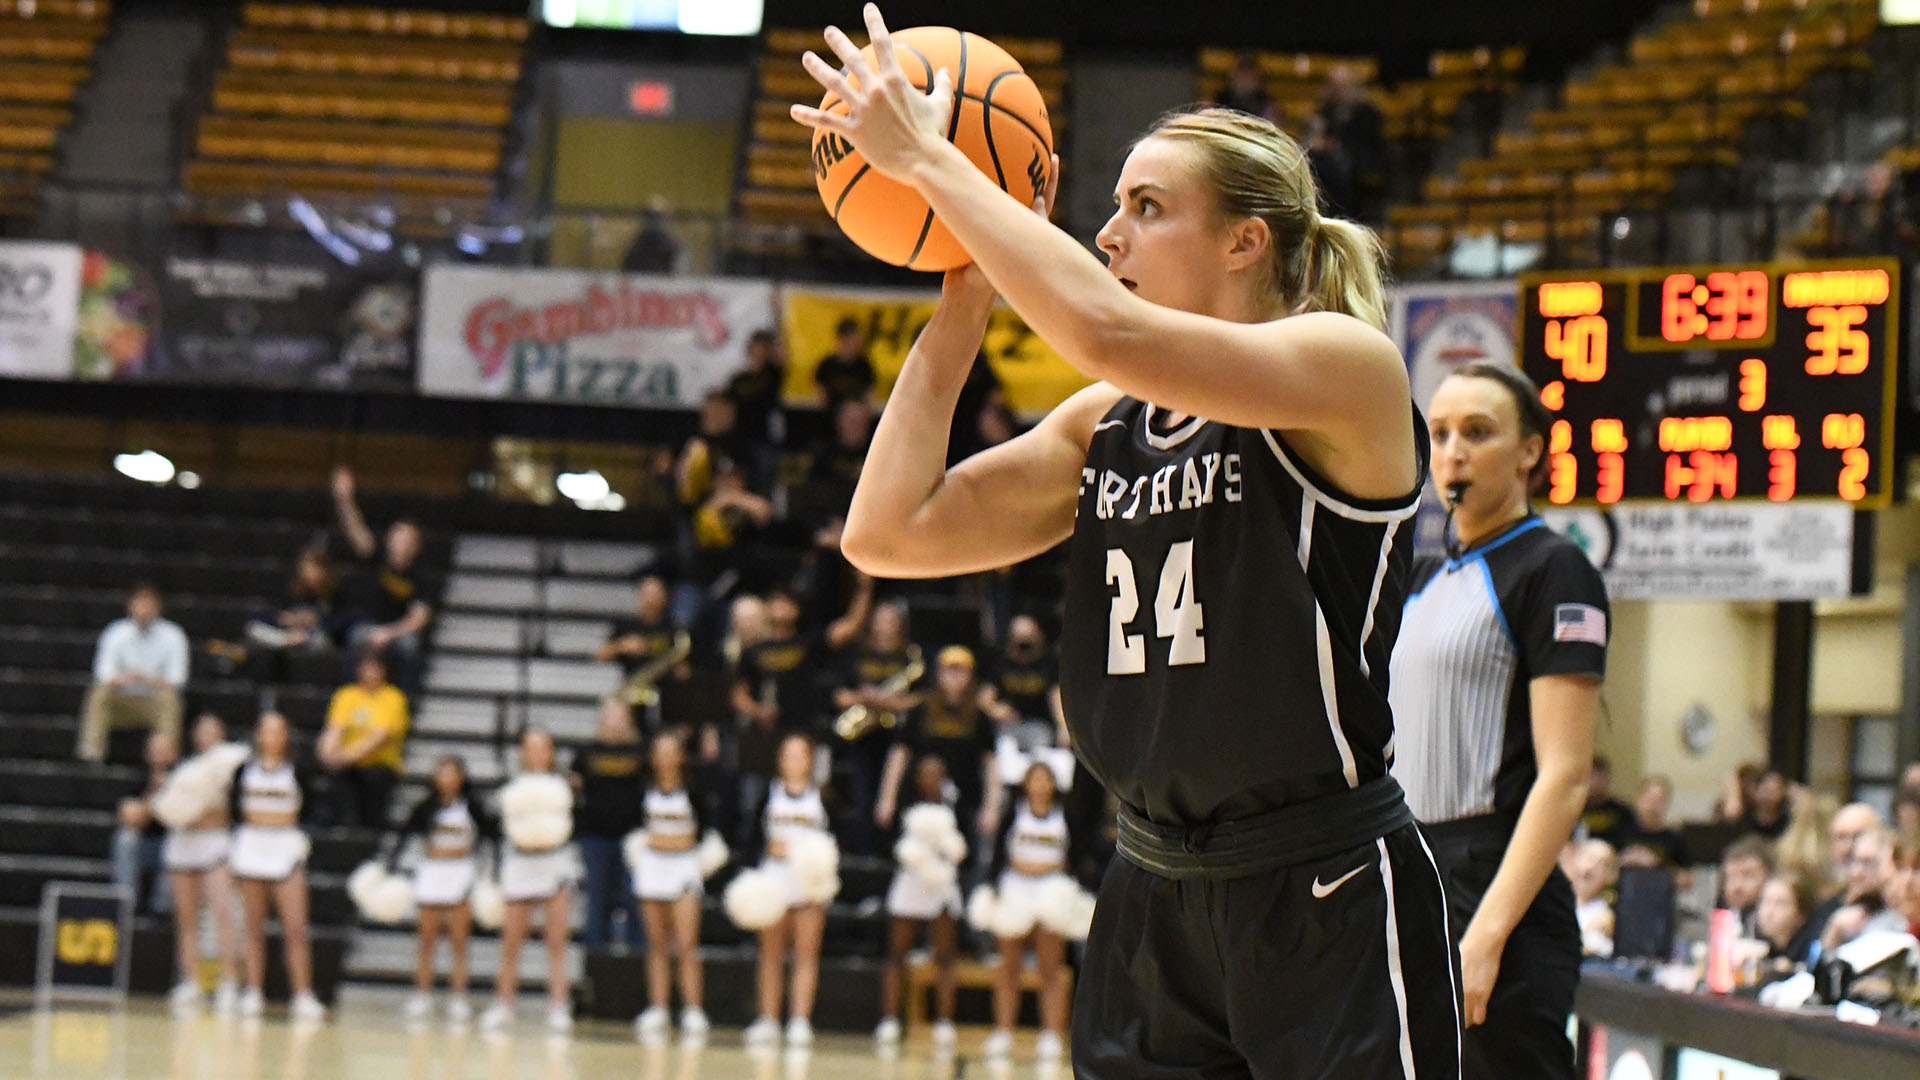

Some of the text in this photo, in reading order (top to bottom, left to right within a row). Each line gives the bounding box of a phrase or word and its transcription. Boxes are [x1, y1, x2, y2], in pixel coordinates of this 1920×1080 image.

[1661, 271, 1769, 342] 6:39
[511, 338, 680, 399] Pizza
[1544, 315, 1608, 382] 40
[1804, 305, 1870, 375] 35
[1738, 358, 1767, 412] 3
[1150, 452, 1242, 515] HAYS
[1597, 452, 1624, 504] 3
[1768, 449, 1796, 502] 3
[1838, 447, 1869, 501] 2
[1106, 538, 1205, 676] 24
